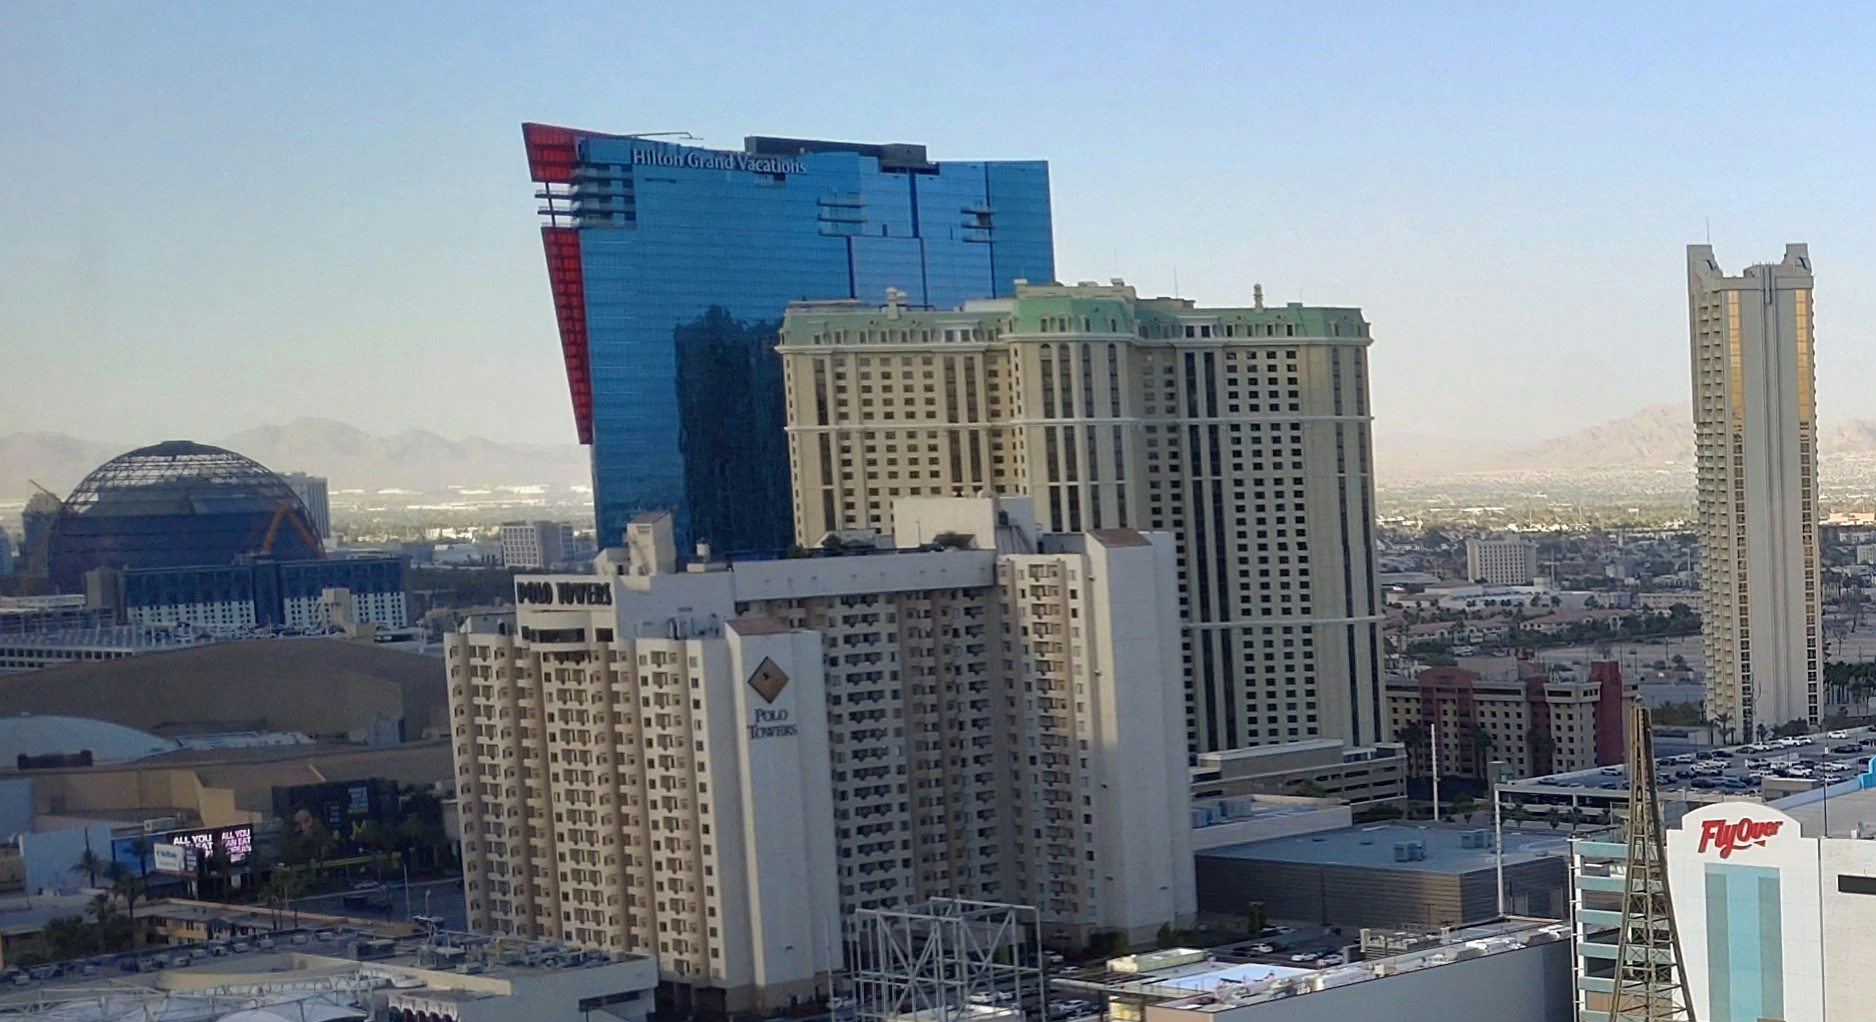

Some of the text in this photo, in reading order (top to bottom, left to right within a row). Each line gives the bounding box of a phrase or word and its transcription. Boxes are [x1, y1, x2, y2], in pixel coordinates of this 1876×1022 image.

[633, 149, 807, 174] Hilton Grand Vacations
[516, 581, 612, 606] POLO TOWERS
[754, 708, 788, 723] POLO
[747, 724, 797, 740] TOWERS
[173, 834, 213, 846] ALL YOU
[221, 828, 251, 840] ALL YOU
[1698, 817, 1783, 859] FlyOver
